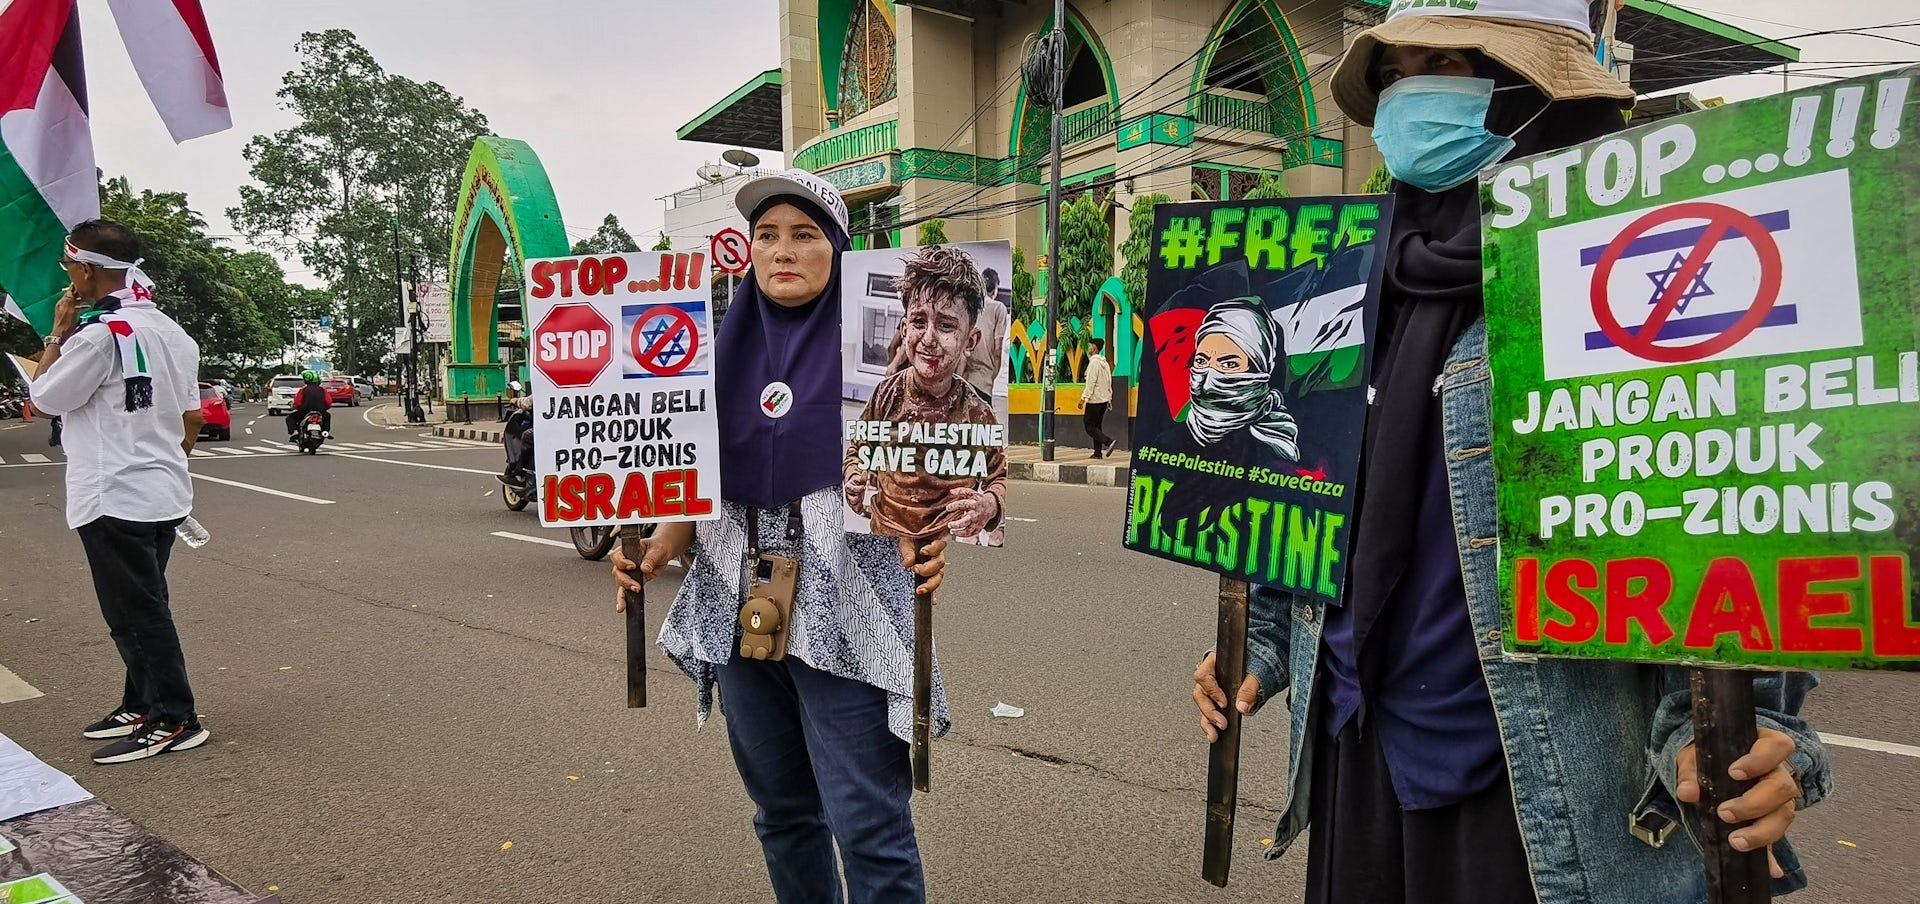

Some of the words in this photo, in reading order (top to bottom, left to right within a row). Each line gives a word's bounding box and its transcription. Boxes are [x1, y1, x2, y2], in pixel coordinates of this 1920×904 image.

[796, 178, 848, 226] ALESTIN
[1158, 203, 1379, 271] #FREE
[540, 329, 607, 362] STOP
[542, 392, 641, 420] JANGAN
[651, 388, 706, 414] BELI
[1512, 369, 1736, 434] JANGAN
[1763, 351, 1920, 414] BELI
[575, 417, 673, 444] PRODUK
[846, 420, 892, 443] FREE
[898, 422, 1004, 447] PALESTINE
[1580, 421, 1825, 484] PRODUK
[555, 442, 697, 471] PRO-ZIONIS
[858, 446, 916, 473] SAVE
[924, 450, 988, 478] GAZA
[1138, 446, 1245, 481] #FreePalestine
[1248, 464, 1345, 499] #SaveGaza
[543, 469, 713, 523] ISRAEL
[1539, 481, 1895, 538] PRO-ZIONIS
[1514, 554, 1920, 657] ISRAEL
